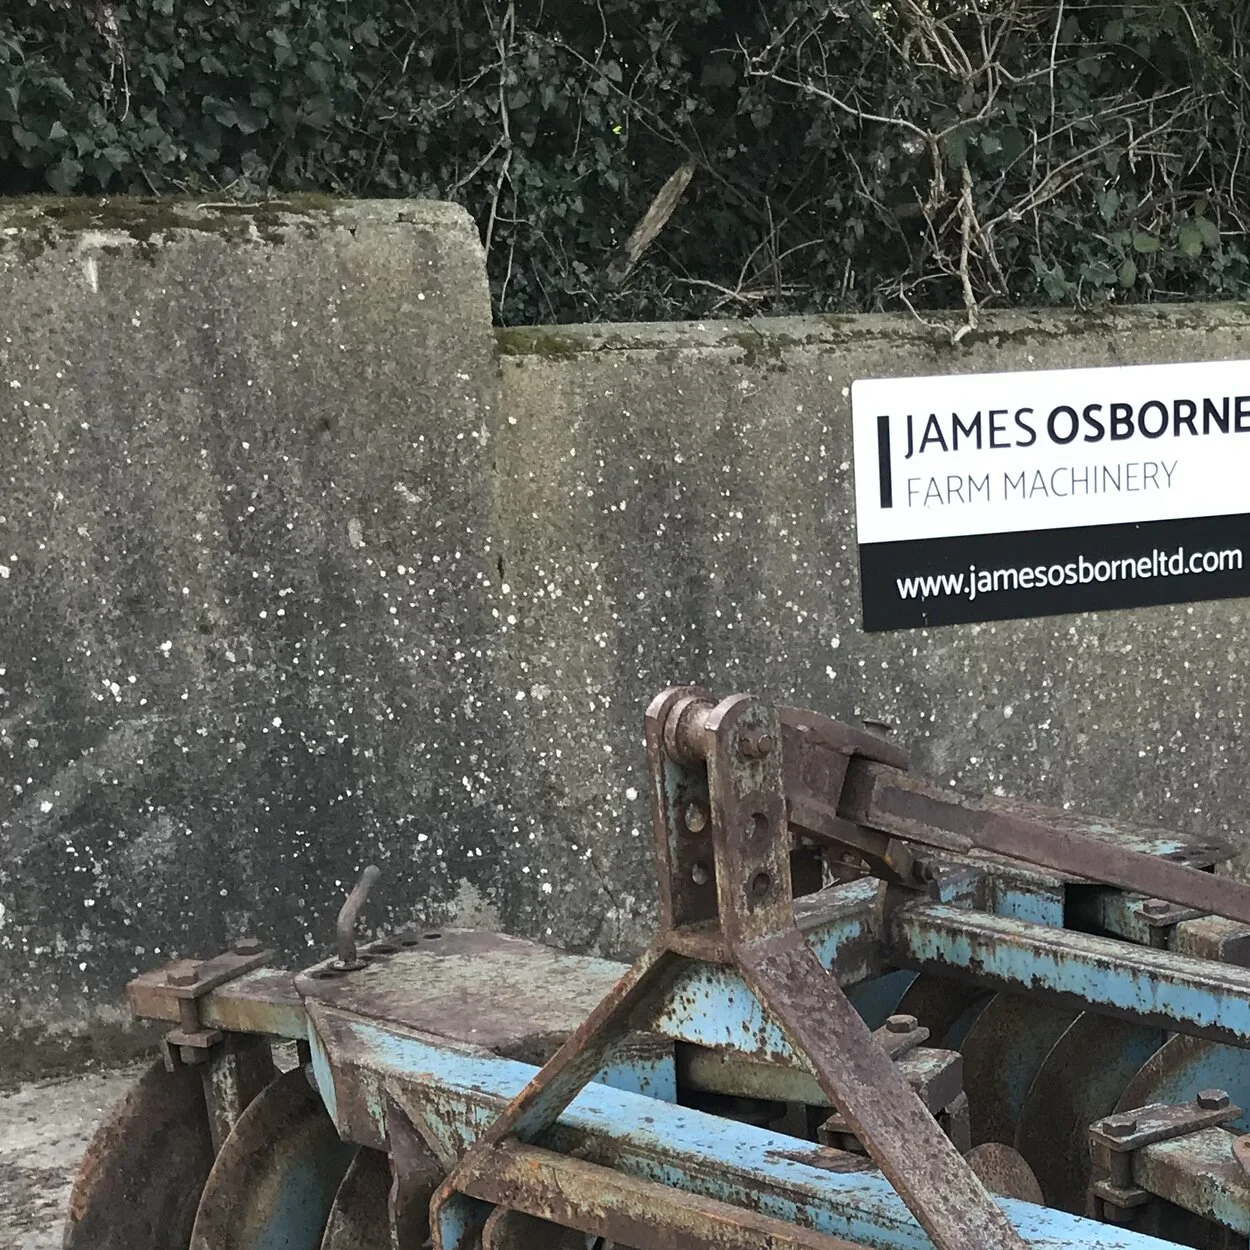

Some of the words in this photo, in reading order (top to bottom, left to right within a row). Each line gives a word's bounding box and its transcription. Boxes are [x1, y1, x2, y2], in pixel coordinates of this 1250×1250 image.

[904, 407, 1037, 460] JAMES
[907, 472, 991, 508] FARM
[1003, 459, 1179, 501] MACHINERY
[896, 546, 1243, 600] www.jamesosborneltd.com
